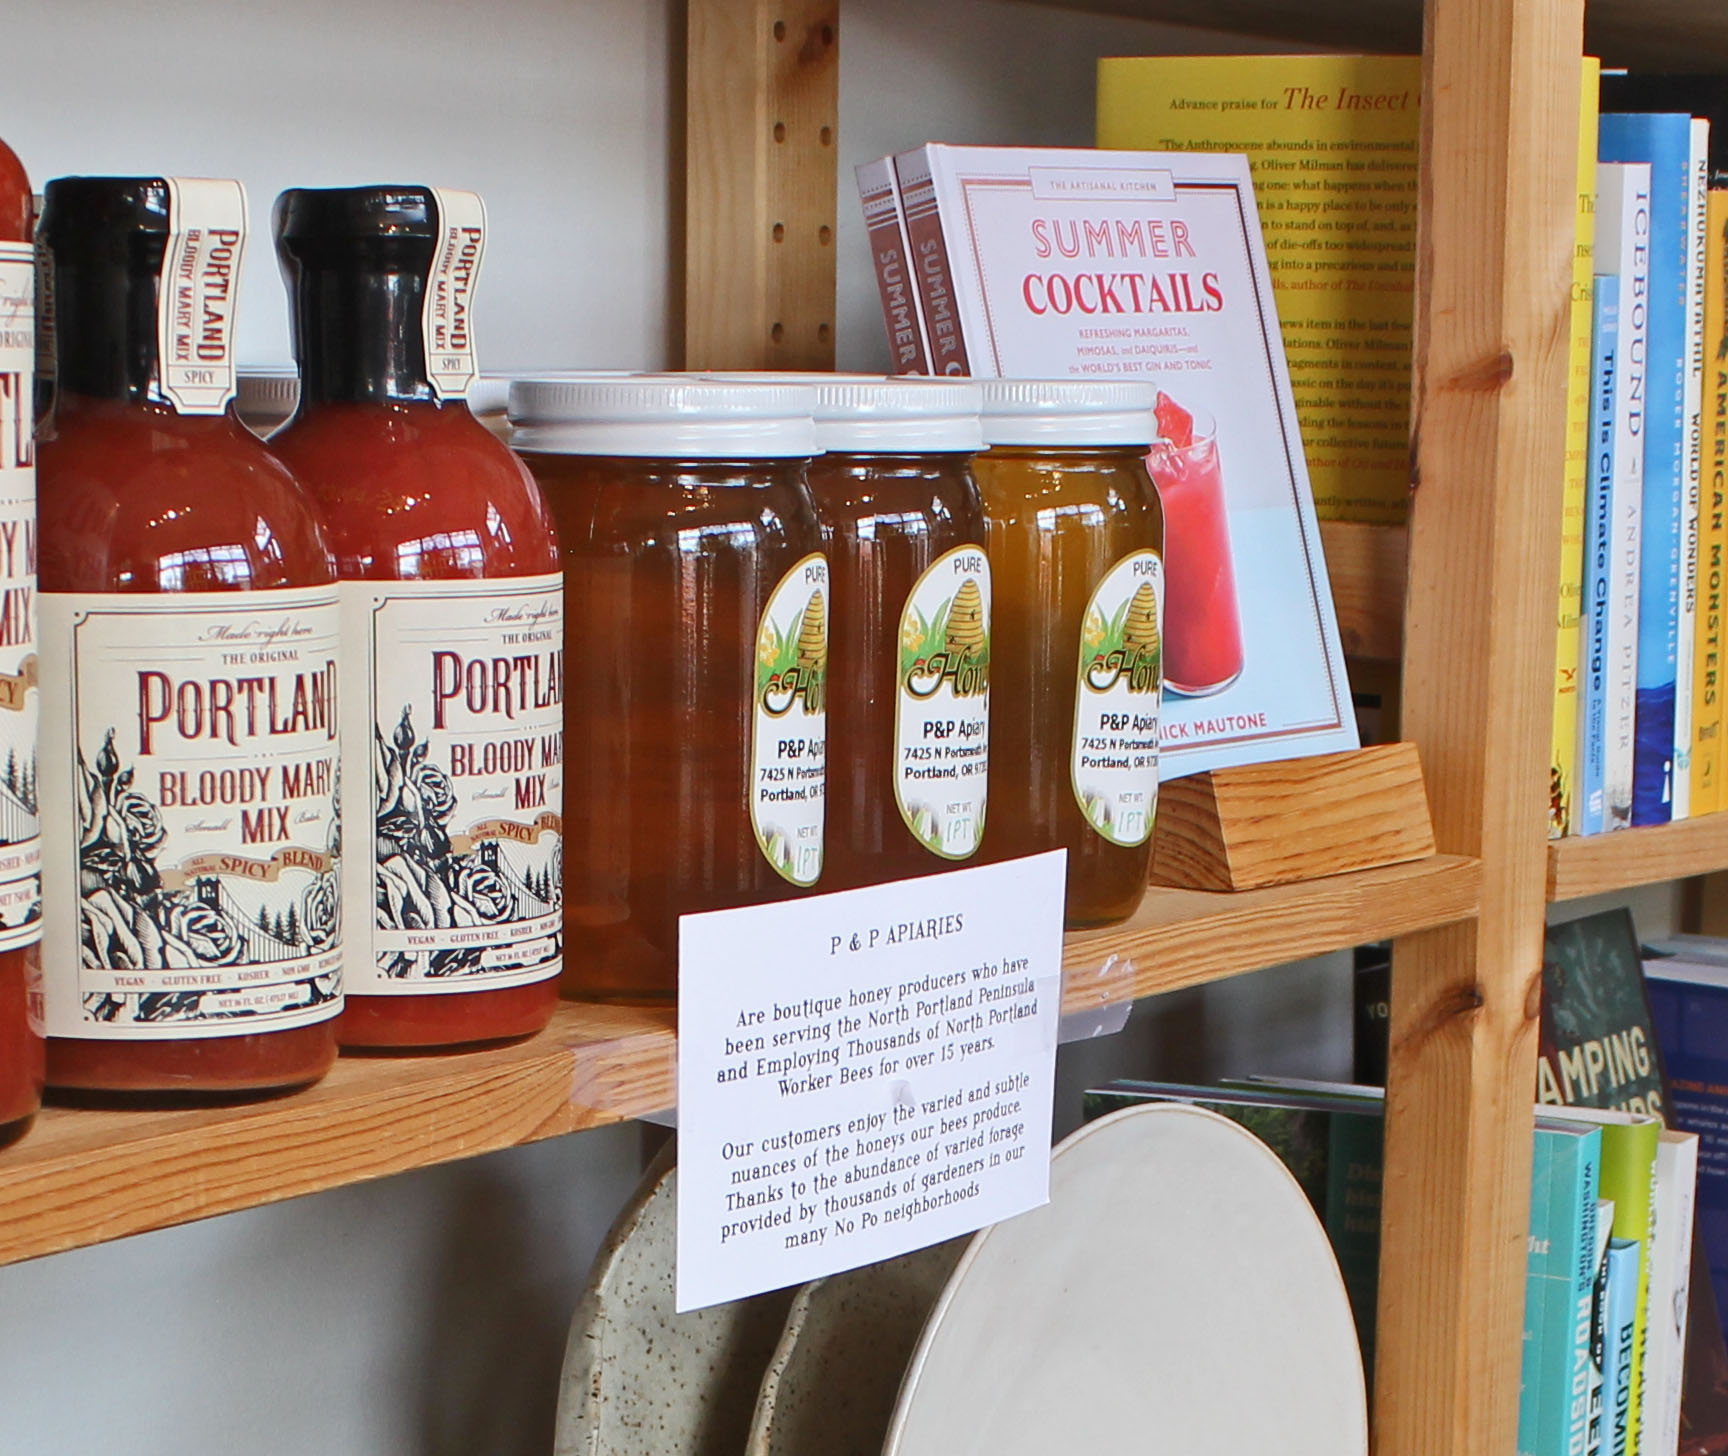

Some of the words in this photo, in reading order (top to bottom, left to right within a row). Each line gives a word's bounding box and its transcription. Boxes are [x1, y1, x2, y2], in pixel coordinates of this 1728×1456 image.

[1170, 98, 1219, 111] Advance
[1221, 99, 1257, 112] praise
[1259, 98, 1278, 110] for
[1283, 87, 1328, 110] The
[1336, 87, 1408, 110] Insect
[1032, 218, 1197, 260] SUMMER
[196, 229, 239, 361] PORTLAND
[1023, 271, 1223, 316] COCKTAILS
[1628, 191, 1651, 438] ICEBOUND
[184, 370, 215, 384] SPICY
[1710, 371, 1728, 538] AMERICAN
[954, 557, 982, 573] PURE
[1704, 544, 1722, 707] MONSTERS
[136, 660, 338, 756] PORTLAND
[923, 722, 955, 739] P&P
[1195, 712, 1267, 735] MAUTONE
[158, 769, 271, 807] BLOODY
[281, 757, 334, 800] MARY
[904, 747, 932, 761] 7425
[905, 766, 958, 781] Portland,
[241, 805, 291, 845] MIX
[219, 856, 271, 880] SPICY
[282, 852, 324, 871] BLEND
[830, 935, 842, 956] P
[849, 932, 862, 953] &
[869, 928, 880, 949] P
[885, 913, 963, 945] APIARIES
[724, 1036, 765, 1056] been
[772, 1022, 832, 1048] serving
[837, 1015, 862, 1038] the
[868, 1003, 910, 1029] North
[915, 989, 973, 1019] Portland
[978, 976, 1035, 1005] Peninsula
[735, 1009, 766, 1028] Are
[773, 996, 843, 1022] boutique
[848, 985, 893, 1007] honey
[897, 971, 967, 1003] producers
[971, 961, 998, 981] who
[1002, 957, 1029, 975] have
[716, 1060, 749, 1084] and
[756, 1046, 841, 1077] Employing
[846, 1026, 921, 1058] Thousands
[926, 1020, 941, 1041] of
[946, 1012, 983, 1037] North
[988, 997, 1038, 1026] Portland
[777, 1073, 833, 1097] Worker
[839, 1065, 873, 1085] Bees
[879, 1057, 900, 1077] for
[905, 1051, 935, 1070] over
[941, 1042, 955, 1062] 15
[959, 1037, 995, 1061] years.
[721, 1142, 755, 1161] Our
[761, 1123, 841, 1153] customers
[847, 1112, 887, 1134] enjoy
[893, 1098, 916, 1126] the
[921, 1088, 963, 1115] varied
[967, 1080, 991, 1103] and
[995, 1071, 1030, 1095] subtle
[731, 1158, 797, 1185] nuances
[803, 1147, 819, 1169] of
[825, 1144, 850, 1167] the
[855, 1132, 905, 1157] honeys
[910, 1125, 935, 1143] our
[939, 1115, 968, 1135] bees
[972, 1101, 1022, 1131] produce.
[721, 1205, 792, 1245] provided
[799, 1202, 817, 1224] by
[823, 1180, 897, 1217] thousands
[902, 1173, 917, 1194] of
[921, 1158, 985, 1193] gardeners
[989, 1152, 1001, 1168] in
[1005, 1145, 1025, 1163] our
[725, 1184, 784, 1212] Thanks
[790, 1181, 807, 1201] to
[813, 1172, 838, 1195] the
[844, 1147, 921, 1185] abundance
[926, 1142, 940, 1163] of
[944, 1129, 985, 1157] varied
[989, 1123, 1025, 1145] forage
[784, 1226, 828, 1249] many
[835, 1217, 855, 1237] No
[861, 1211, 879, 1230] Po
[883, 1180, 980, 1223] neighborhoods
